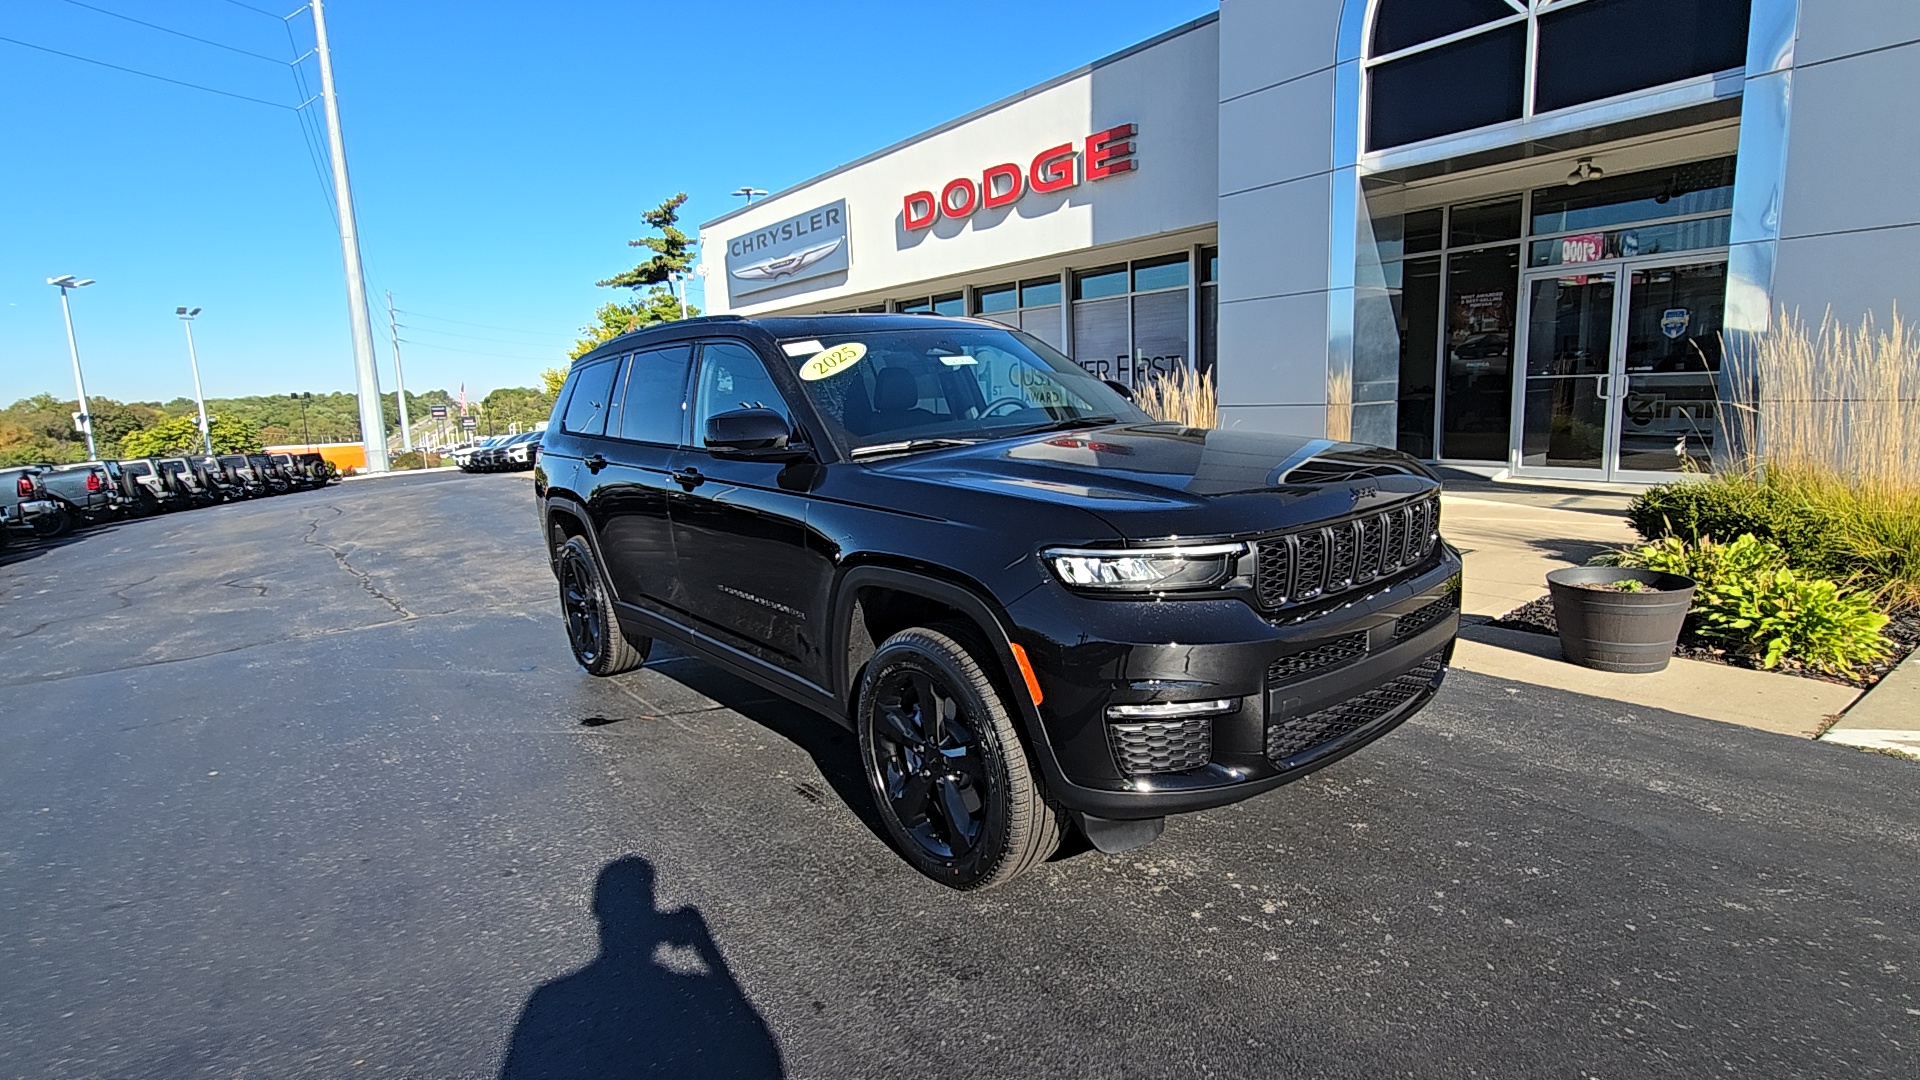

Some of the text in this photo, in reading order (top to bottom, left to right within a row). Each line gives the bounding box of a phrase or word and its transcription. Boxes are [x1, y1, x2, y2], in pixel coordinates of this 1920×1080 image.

[903, 123, 1137, 231] DODGE
[731, 208, 840, 257] CHRYSLER
[812, 346, 857, 375] 2025
[1117, 355, 1181, 381] FRST
[1025, 392, 1060, 403] AWARD
[1350, 487, 1377, 501] Jeep
